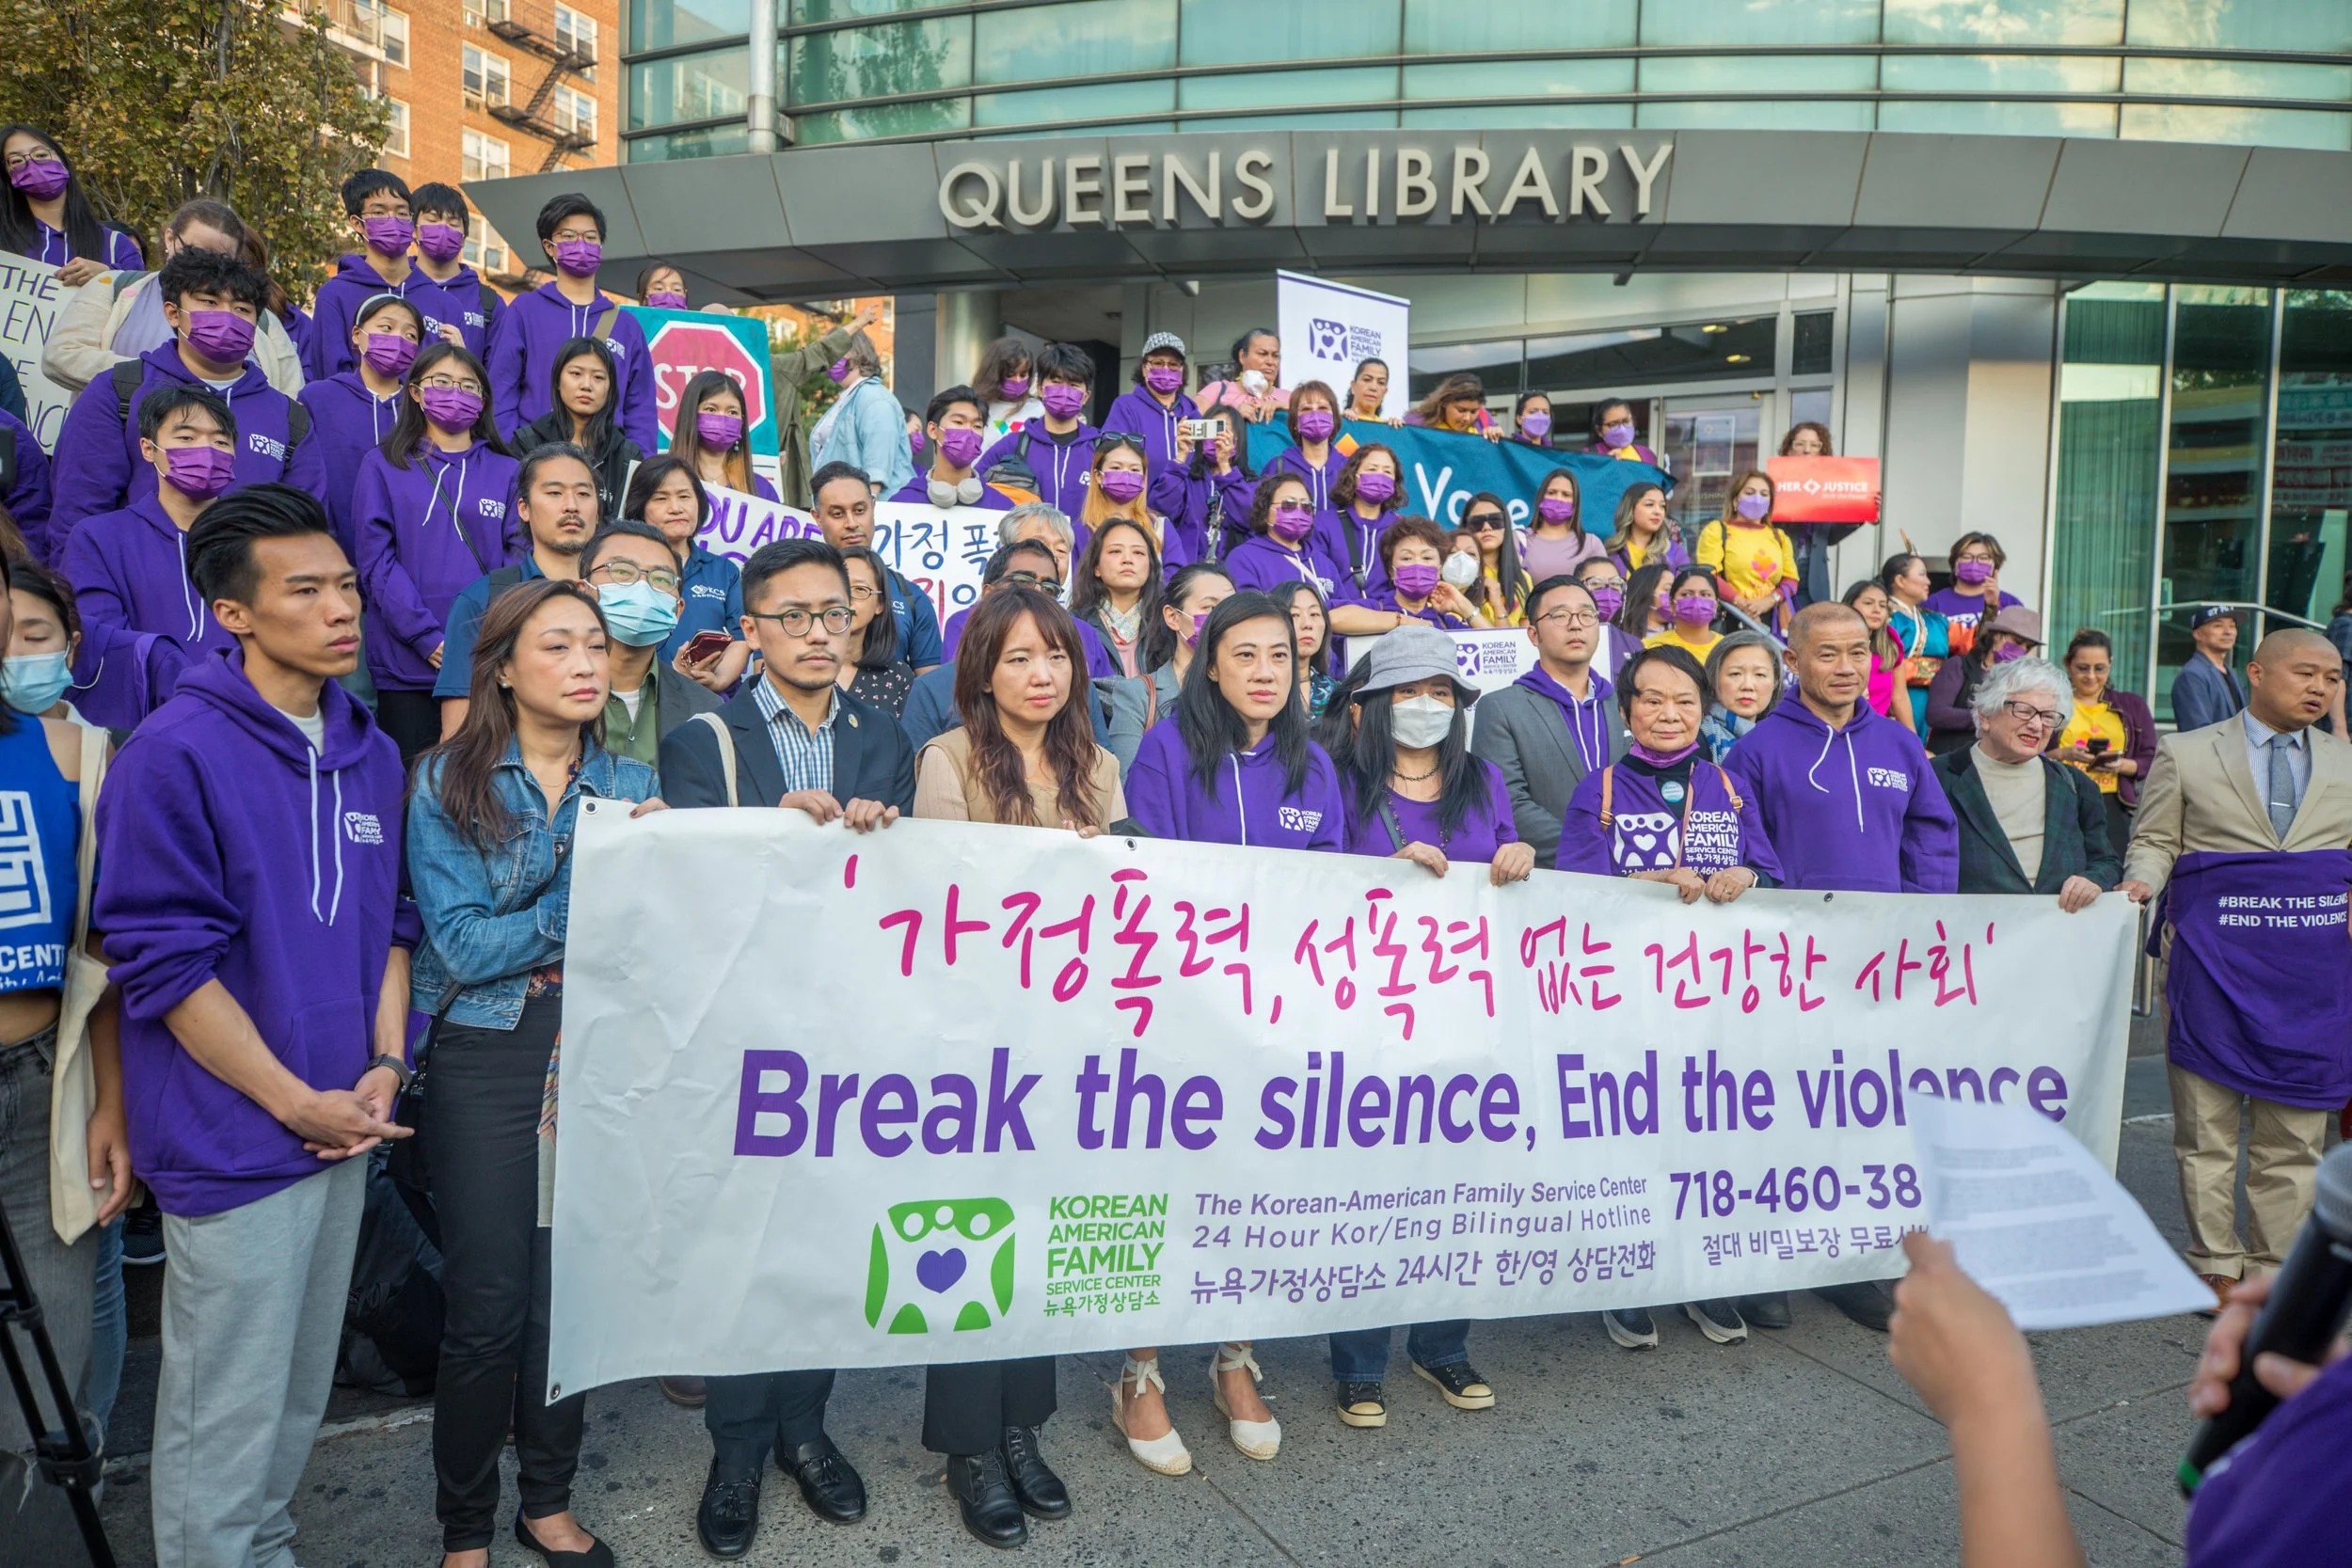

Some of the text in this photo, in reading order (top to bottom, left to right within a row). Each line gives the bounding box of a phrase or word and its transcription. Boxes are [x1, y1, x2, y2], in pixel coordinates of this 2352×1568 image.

[939, 145, 1674, 231] QUEENS LIBRARY
[0, 263, 59, 302] THE
[1349, 325, 1381, 340] KOREAN
[1350, 334, 1381, 347] AMERICAN
[1350, 341, 1381, 357] FAMILY
[654, 363, 746, 409] STP
[1777, 481, 1868, 493] HER JUSTICE
[961, 524, 1001, 576] 폭
[1482, 641, 1517, 650] KOREAN
[1483, 656, 1517, 664] FAMILY
[1687, 823, 1739, 834] AMERICAN
[1689, 811, 1738, 824] KOREAN
[1685, 832, 1739, 848] FAMILY
[2218, 896, 2281, 909] #BREAK
[2285, 897, 2315, 909] THE
[2218, 914, 2261, 927] #END
[2265, 915, 2297, 927] THE
[1520, 914, 1622, 1015] 없는
[1644, 927, 1828, 1014] 건강한
[734, 1047, 1043, 1158] Break
[1075, 1047, 1224, 1150] the
[1254, 1051, 1536, 1151] silence,
[1557, 1050, 1660, 1139] End
[1681, 1050, 1775, 1133] the
[1049, 1193, 1168, 1220] KOREAN
[1195, 1176, 1647, 1216] The Korean-American Family Service Center
[1047, 1220, 1166, 1244] AMERICAN
[1192, 1204, 1652, 1249] 24 Hour Kor/Eng Bilingual Hotline
[1703, 1231, 1741, 1266] 절대
[1749, 1227, 1840, 1261] 비밀보장
[1850, 1224, 1929, 1256] 무료
[1047, 1242, 1165, 1279] FAMILY
[1190, 1240, 1657, 1305] 뉴욕가정상담소 24시간 한/영 상담전화
[1046, 1275, 1161, 1296] SERVICE CENTER
[1043, 1290, 1161, 1318] 뉴욕가정상담소
